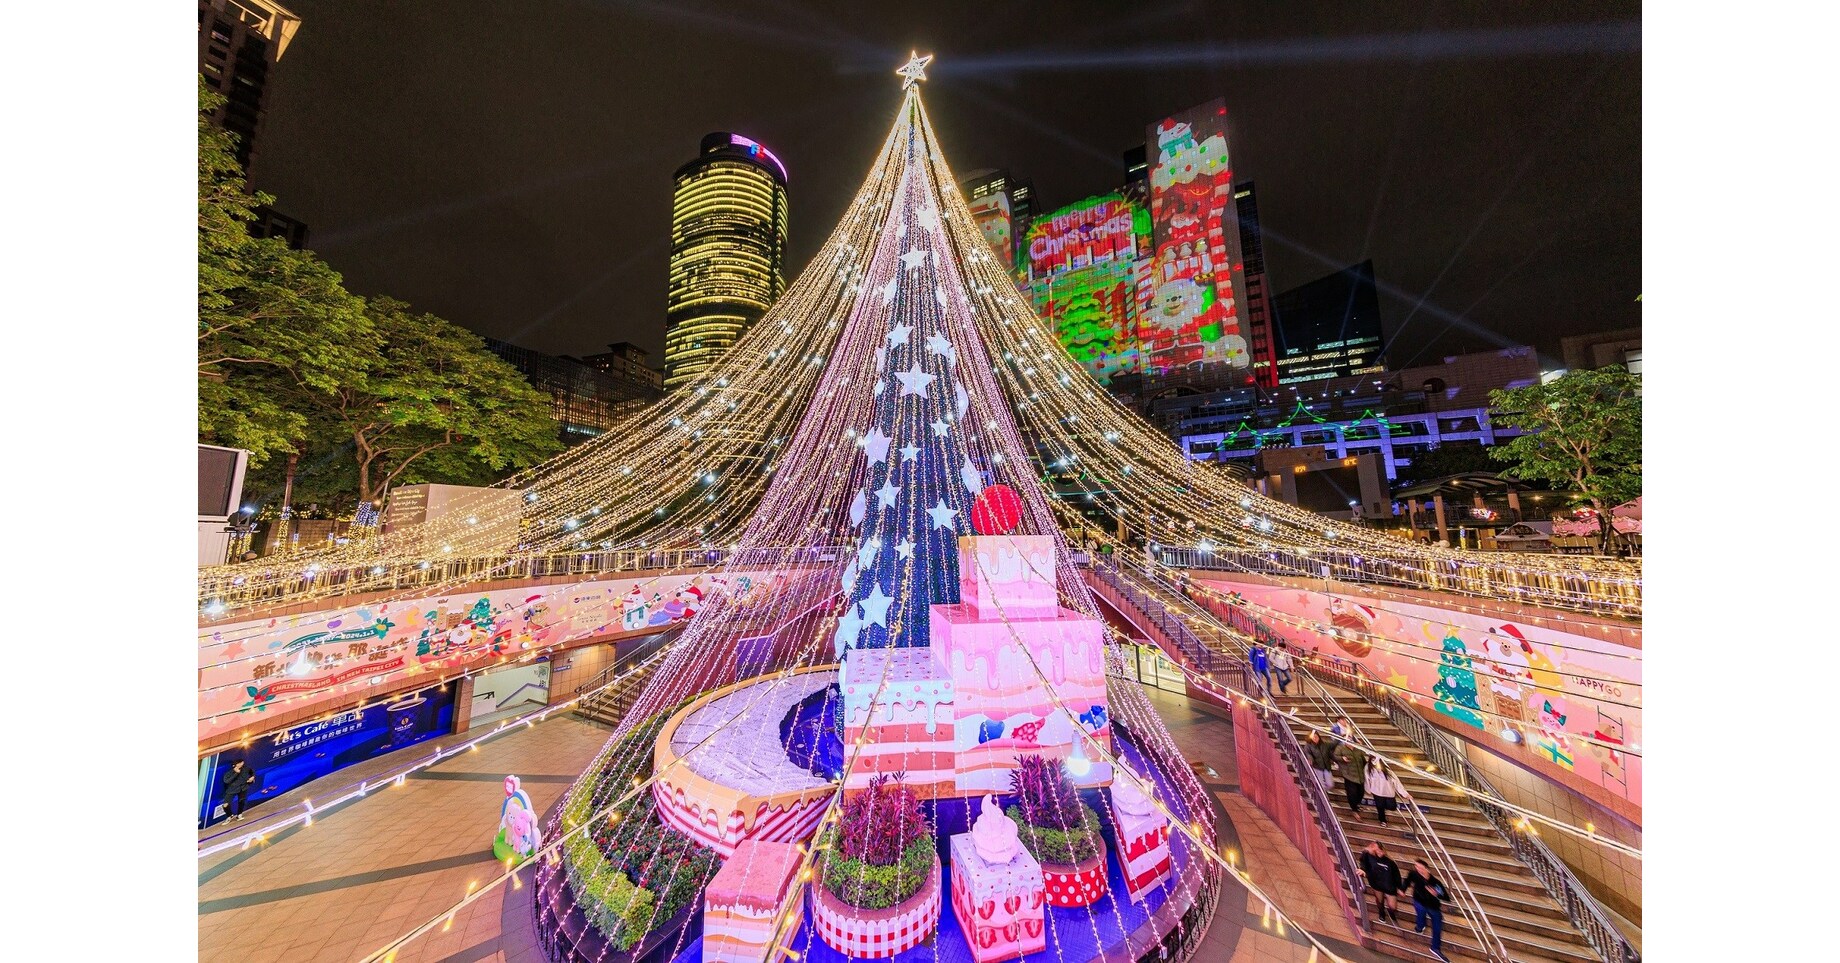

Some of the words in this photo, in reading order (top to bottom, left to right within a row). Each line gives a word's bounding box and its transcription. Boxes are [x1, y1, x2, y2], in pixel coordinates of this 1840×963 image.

[1029, 213, 1132, 260] Christmas
[271, 678, 332, 692] CHRISTMASLAND
[345, 670, 360, 679] NEW
[361, 665, 383, 675] TAIPEI
[384, 660, 400, 669] CITY
[304, 721, 329, 736] Café
